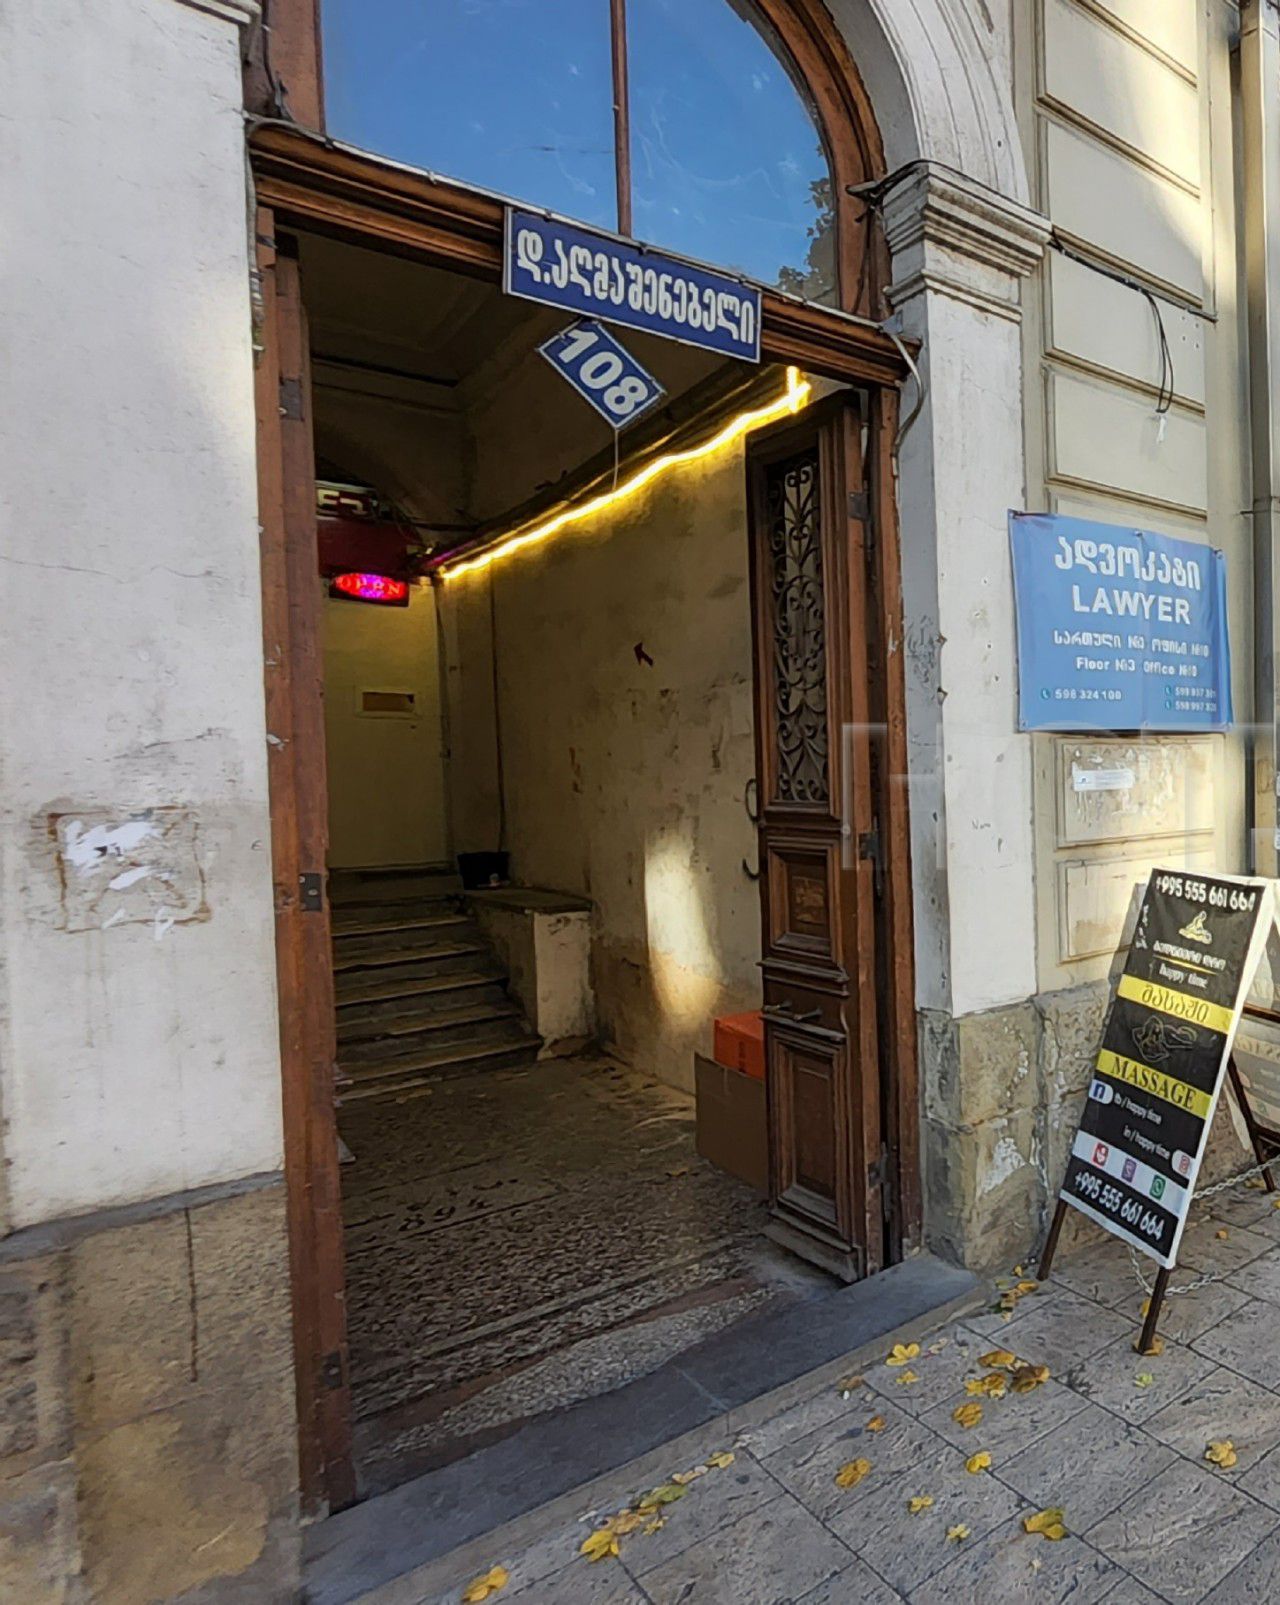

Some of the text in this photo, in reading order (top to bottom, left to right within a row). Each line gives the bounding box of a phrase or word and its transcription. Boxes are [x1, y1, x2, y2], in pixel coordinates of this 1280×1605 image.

[557, 328, 649, 416] 108
[1054, 535, 1201, 591] ადვოკატი
[1072, 584, 1191, 626] LAWYER
[1076, 656, 1110, 671] Floor
[1143, 660, 1176, 676] Office
[1079, 688, 1100, 700] 324
[1156, 875, 1183, 897] +995
[1184, 880, 1207, 903] 555
[1208, 886, 1228, 908] 661
[1141, 985, 1211, 1024] მასაჟი
[1110, 1056, 1197, 1111] MASSAGE
[1075, 1171, 1165, 1241] +995 555 661 664
